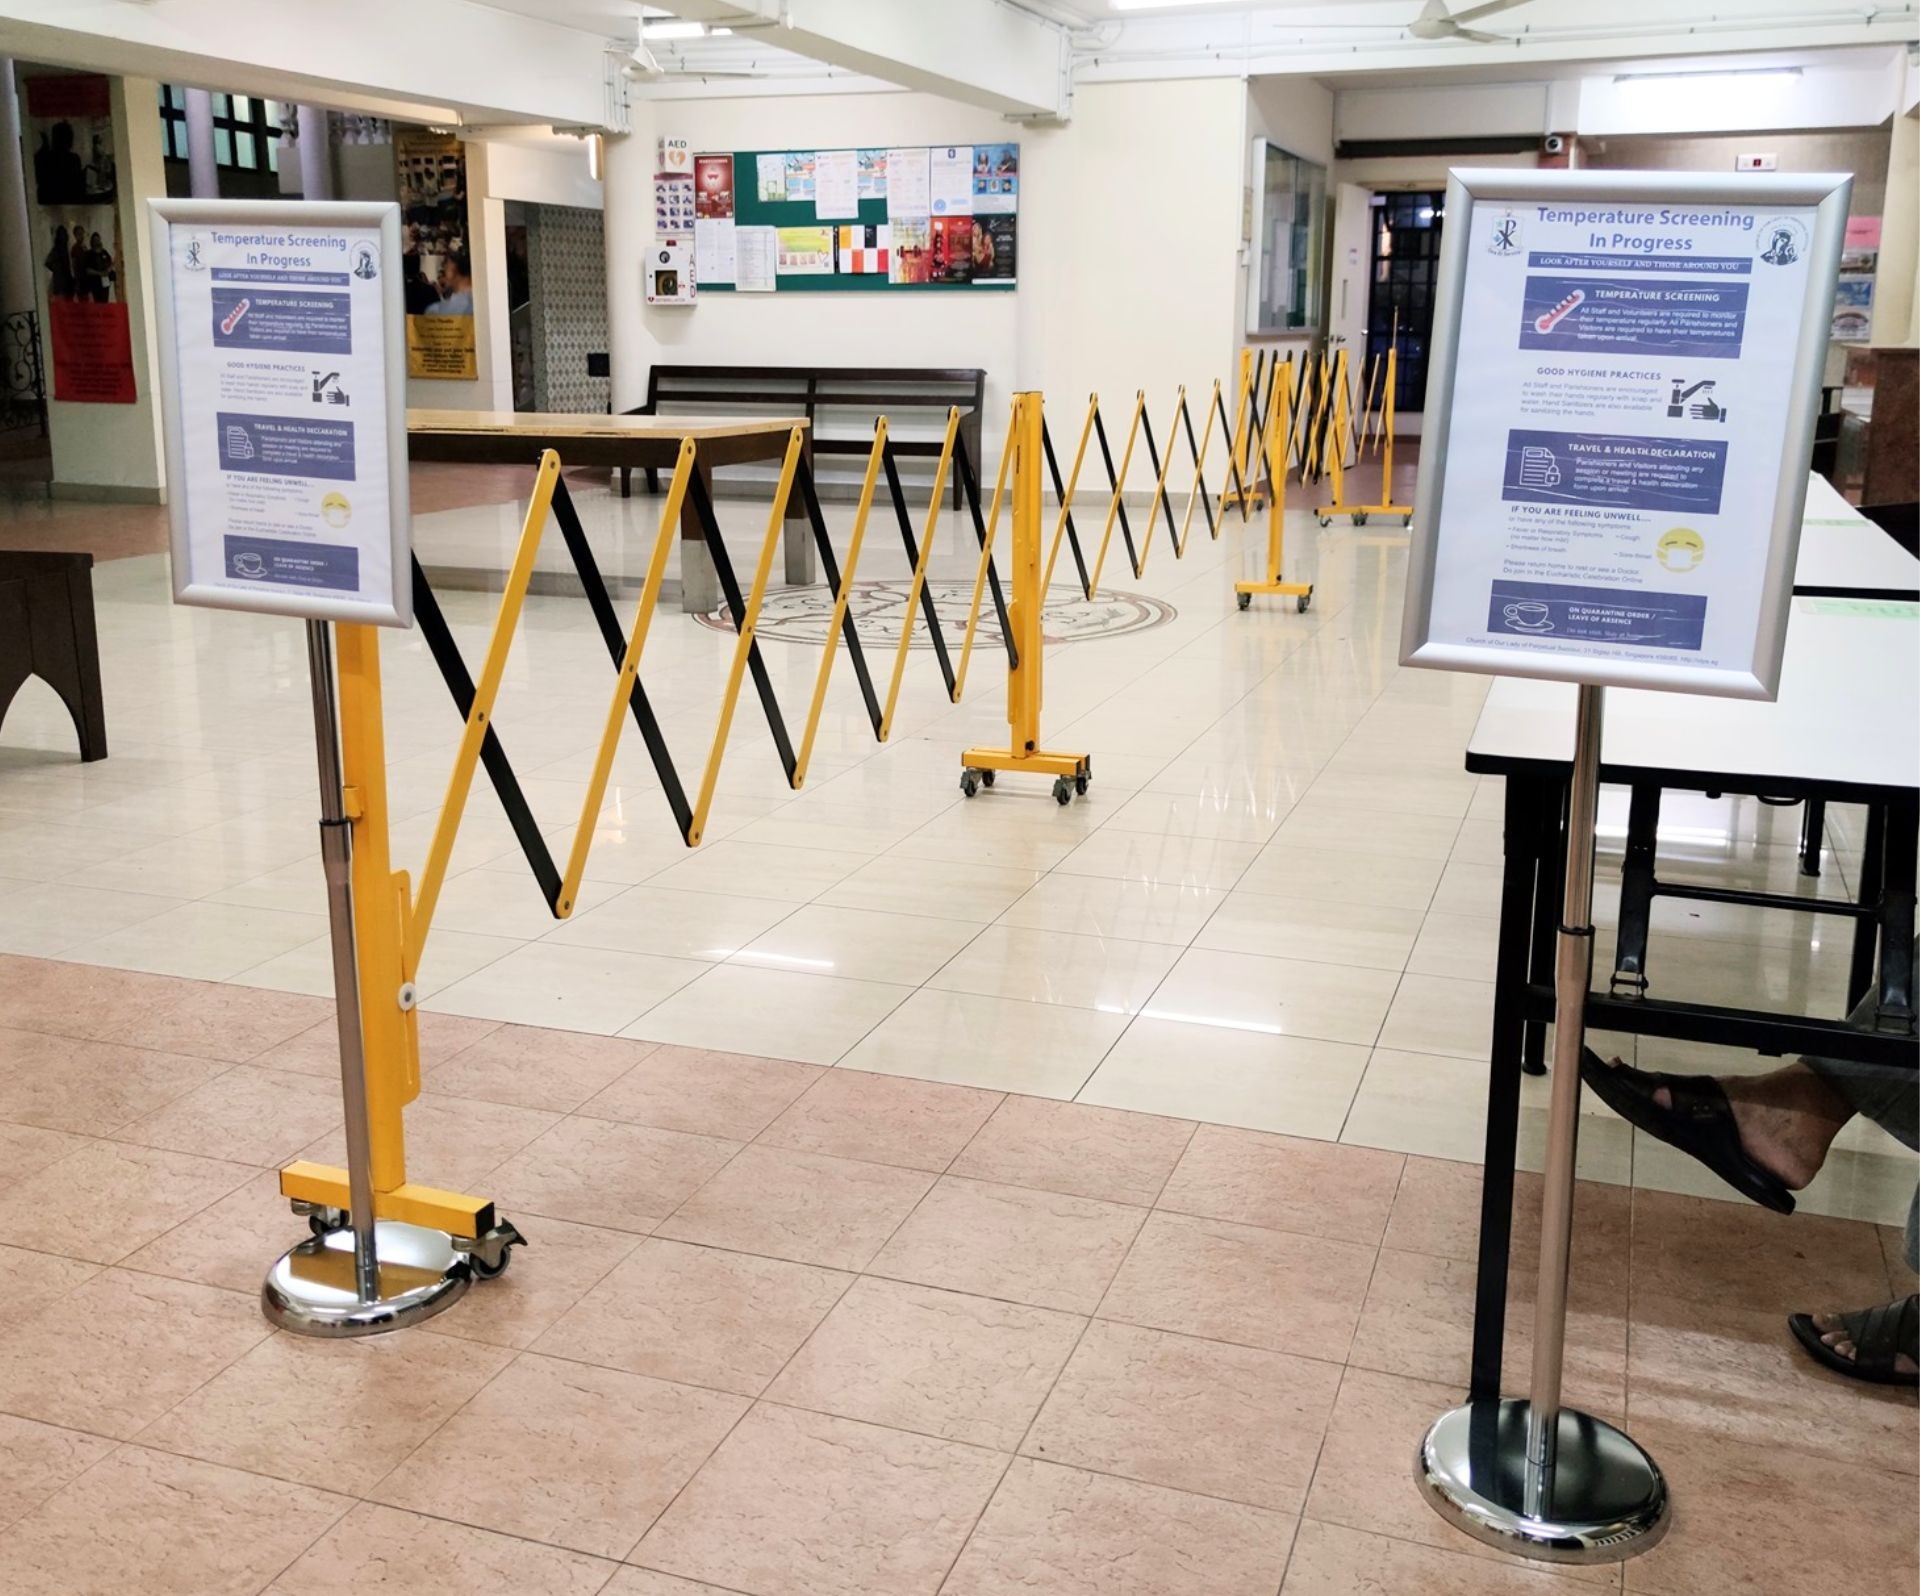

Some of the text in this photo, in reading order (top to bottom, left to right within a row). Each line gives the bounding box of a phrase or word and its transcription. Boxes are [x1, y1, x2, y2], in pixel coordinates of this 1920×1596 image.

[668, 140, 687, 149] AED
[1536, 206, 1755, 231] Temperature Screening
[210, 231, 346, 251] Temperature Screening
[1589, 233, 1693, 253] In Progress
[246, 252, 311, 269] In Progress
[1539, 256, 1739, 270] LOOK AFTER YOURSELF AND THOSE AROUND YOU
[1594, 289, 1720, 302] TEMPERATURE SCREENING
[255, 298, 333, 308] TEMPERATURE SCREENING
[246, 362, 271, 370] HYGIENE
[272, 364, 305, 372] PRACTICES
[1536, 366, 1661, 380] GOOD HYGIENE PRACTICES
[254, 423, 275, 431] TRAVEL
[306, 427, 347, 436] DECLARATION
[1567, 444, 1601, 453] TRAVEL
[1613, 446, 1648, 456] HEALTH
[1649, 448, 1715, 460] DECLARATION
[259, 476, 282, 484] FEELING
[1522, 505, 1542, 514] YOU
[1544, 507, 1561, 515] ARE
[1564, 508, 1601, 518] FEELING
[1567, 613, 1633, 625] LEAVE OF ABSENCE
[1580, 607, 1626, 618] QUARANTINE
[1626, 611, 1650, 620] ORDER
